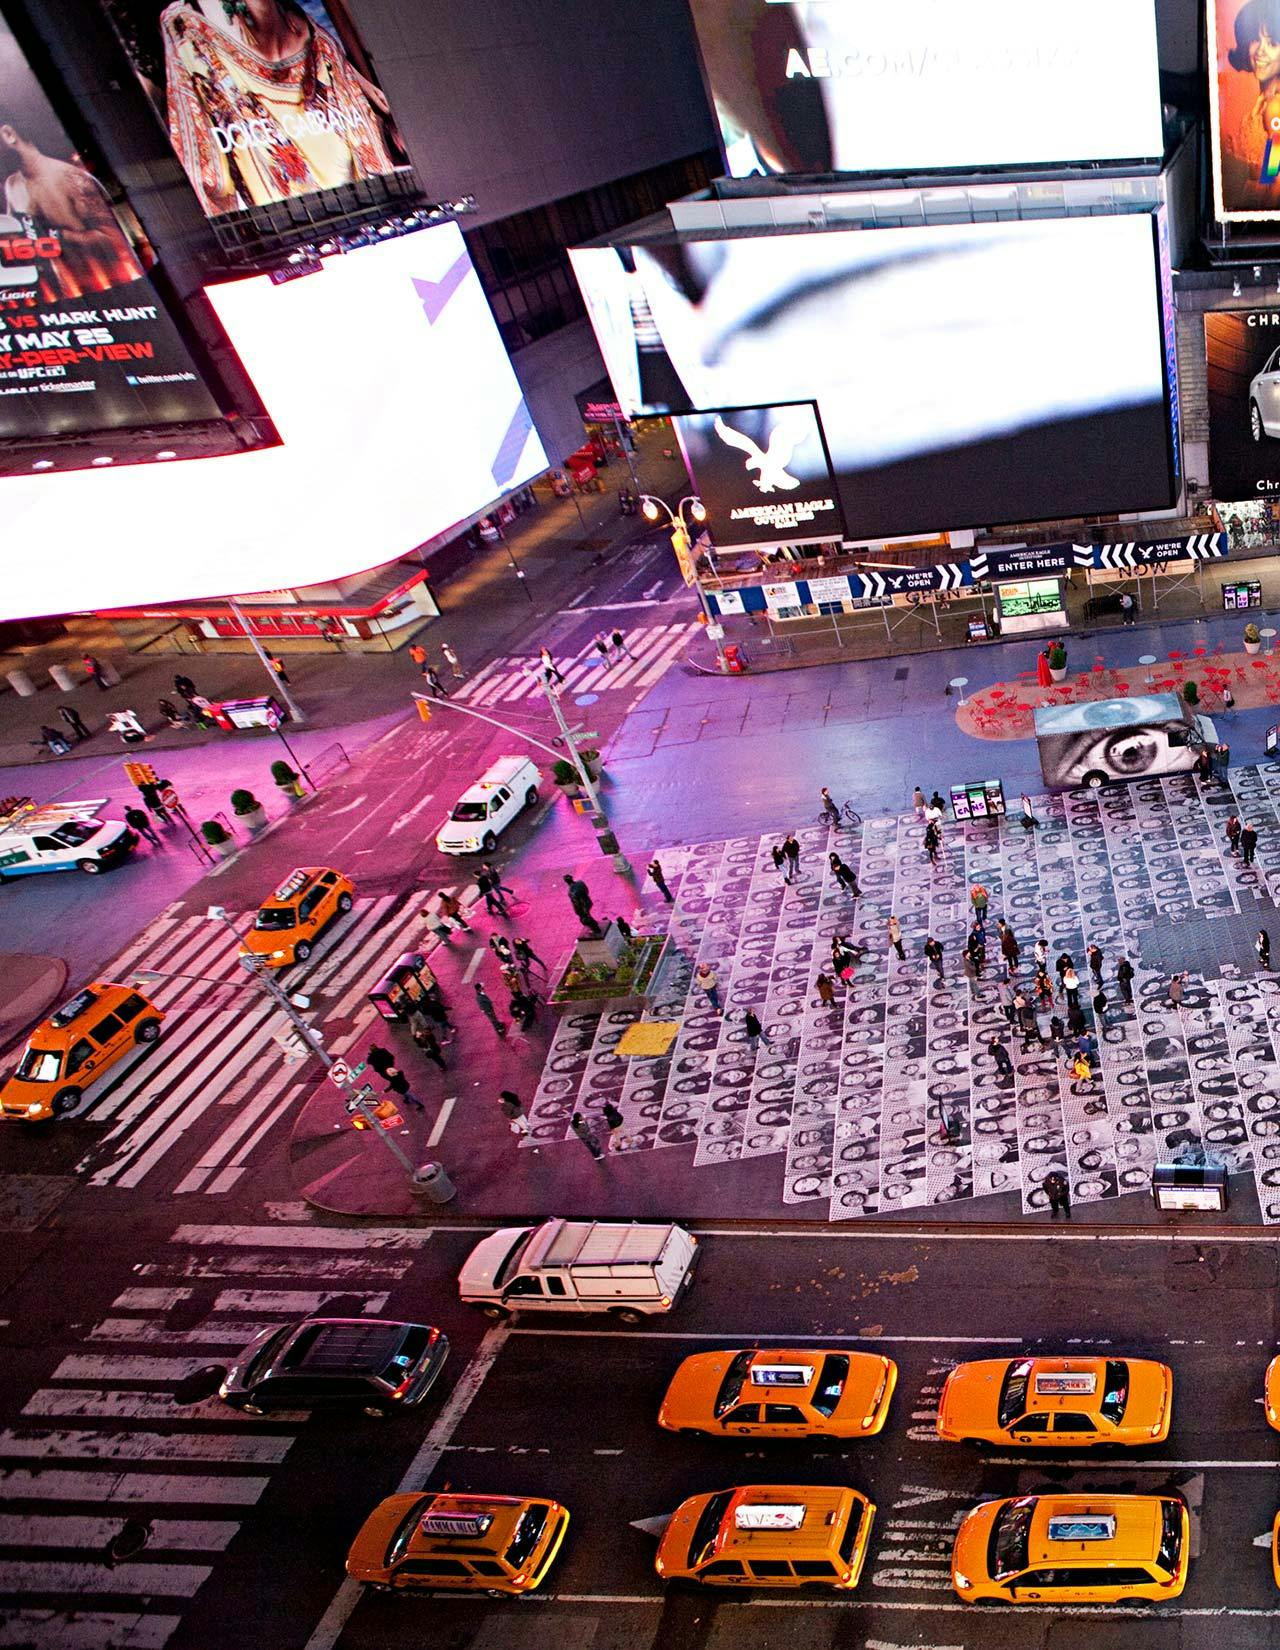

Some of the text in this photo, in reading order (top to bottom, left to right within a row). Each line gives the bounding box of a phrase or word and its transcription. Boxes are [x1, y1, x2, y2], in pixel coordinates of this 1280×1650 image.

[211, 118, 277, 153] DOLCE
[282, 106, 367, 138] GABBANA
[7, 315, 37, 328] VS
[40, 310, 103, 327] MARK
[104, 306, 157, 322] HUNT
[14, 330, 73, 350] MAY
[74, 327, 114, 346] 25
[0, 342, 155, 369] Y-PER-VIEW
[40, 380, 96, 393] ticketmaster
[730, 499, 835, 519] AMERICAN EAGLE
[1155, 542, 1182, 551] WE'RE
[1156, 550, 1179, 558] OPEN
[998, 557, 1065, 572] ENTER HERE
[1118, 561, 1168, 579] NOW
[905, 571, 934, 581] WE'RE
[907, 579, 931, 588] OPEN
